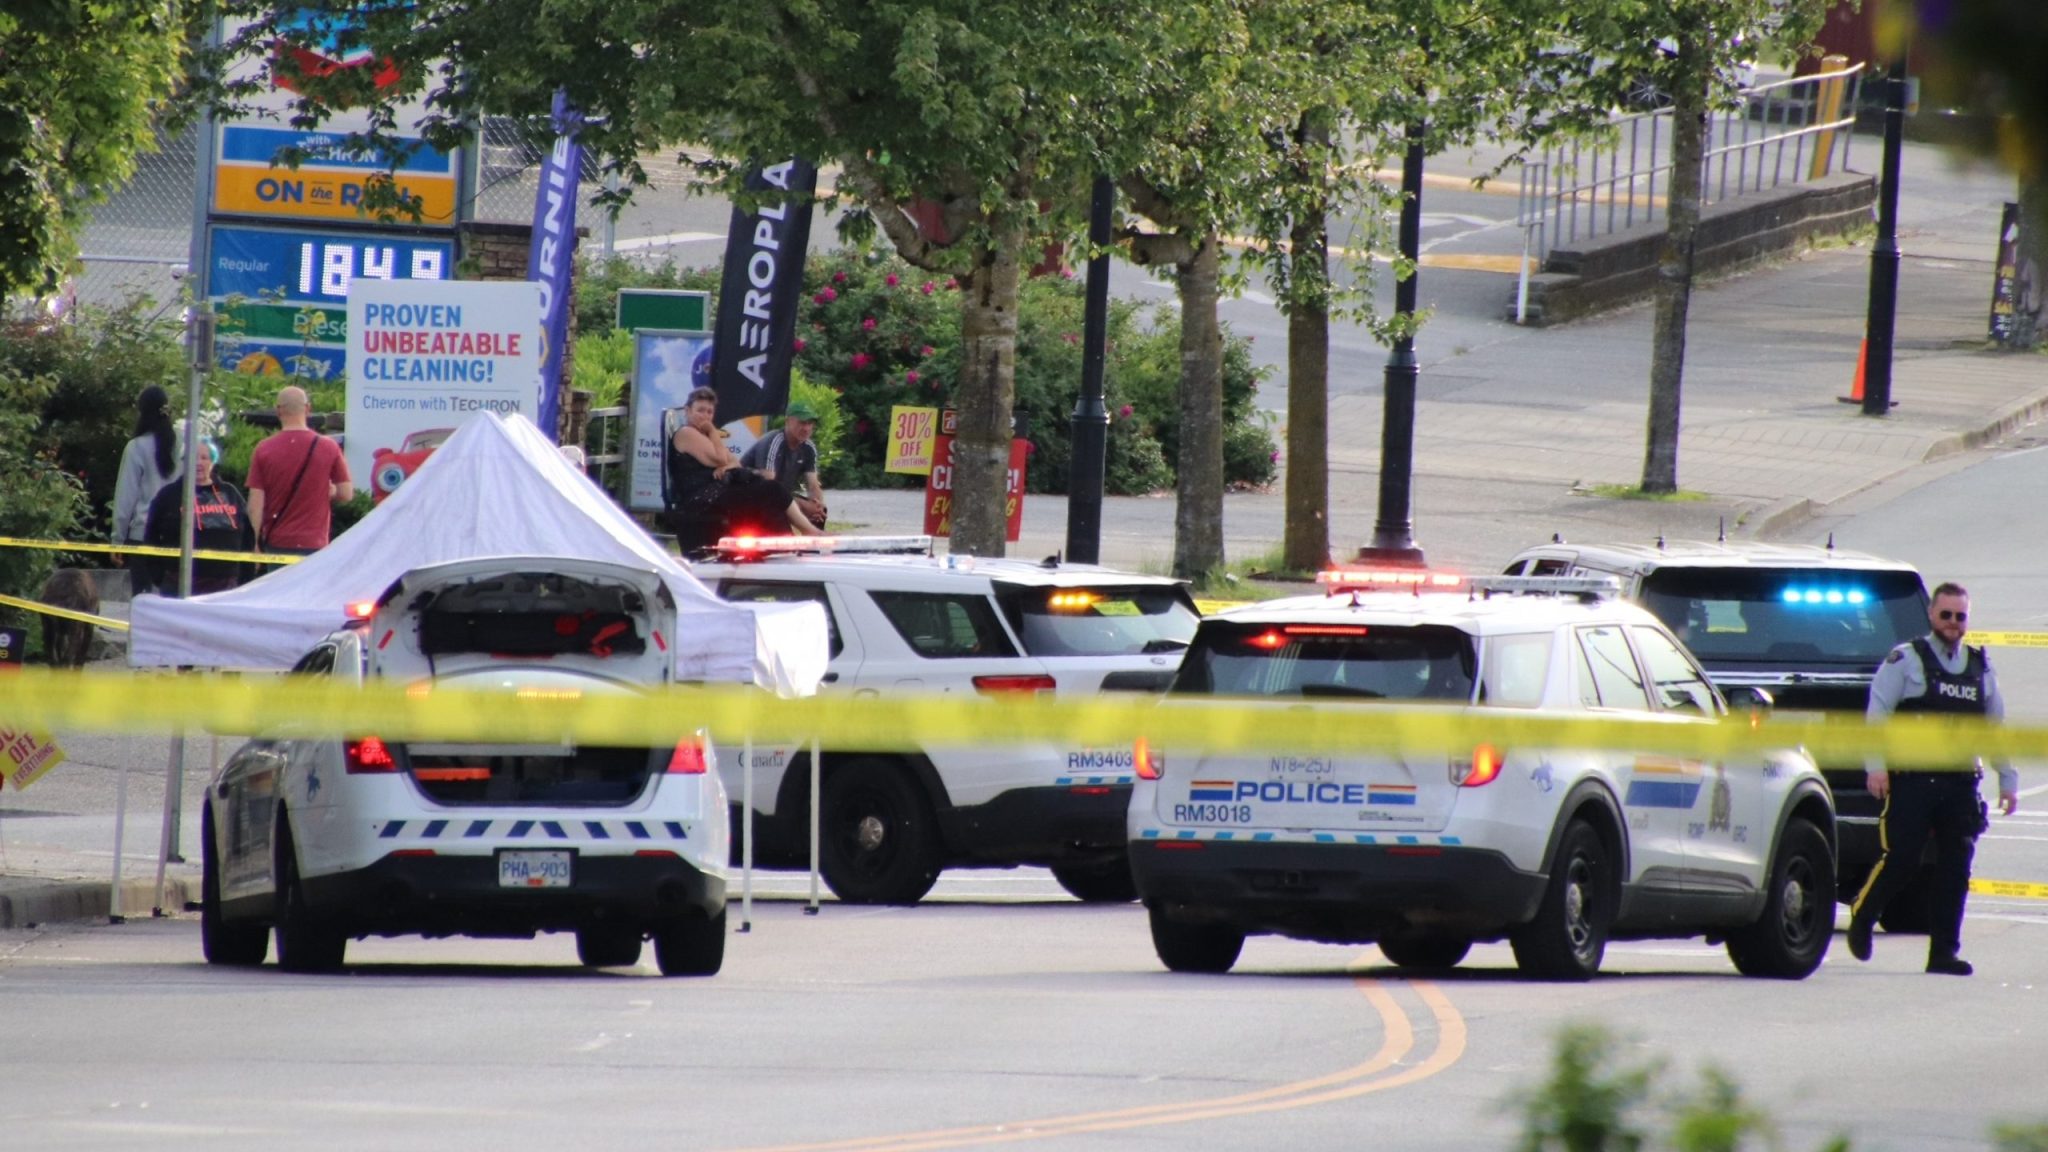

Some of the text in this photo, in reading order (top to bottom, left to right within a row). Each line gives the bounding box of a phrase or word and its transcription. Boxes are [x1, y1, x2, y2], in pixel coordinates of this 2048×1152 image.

[306, 134, 331, 146] with
[255, 178, 305, 204] ON
[311, 186, 333, 201] the
[218, 256, 271, 274] Regular
[736, 158, 795, 389] AEROPLA
[292, 312, 348, 338] Dese
[364, 303, 462, 328] PROVEN
[363, 330, 522, 356] UNBEATABLE
[362, 357, 494, 383] CLEANING!
[363, 395, 521, 413] Chevron with TECHRON
[895, 412, 933, 440] 30%
[900, 441, 922, 457] OFF
[1940, 682, 1977, 701] POLICE
[8, 732, 37, 765] OFF
[738, 751, 784, 768] Cnada
[1068, 751, 1133, 768] RM3403
[1236, 781, 1365, 804] POLICE
[1174, 804, 1251, 823] RM3018
